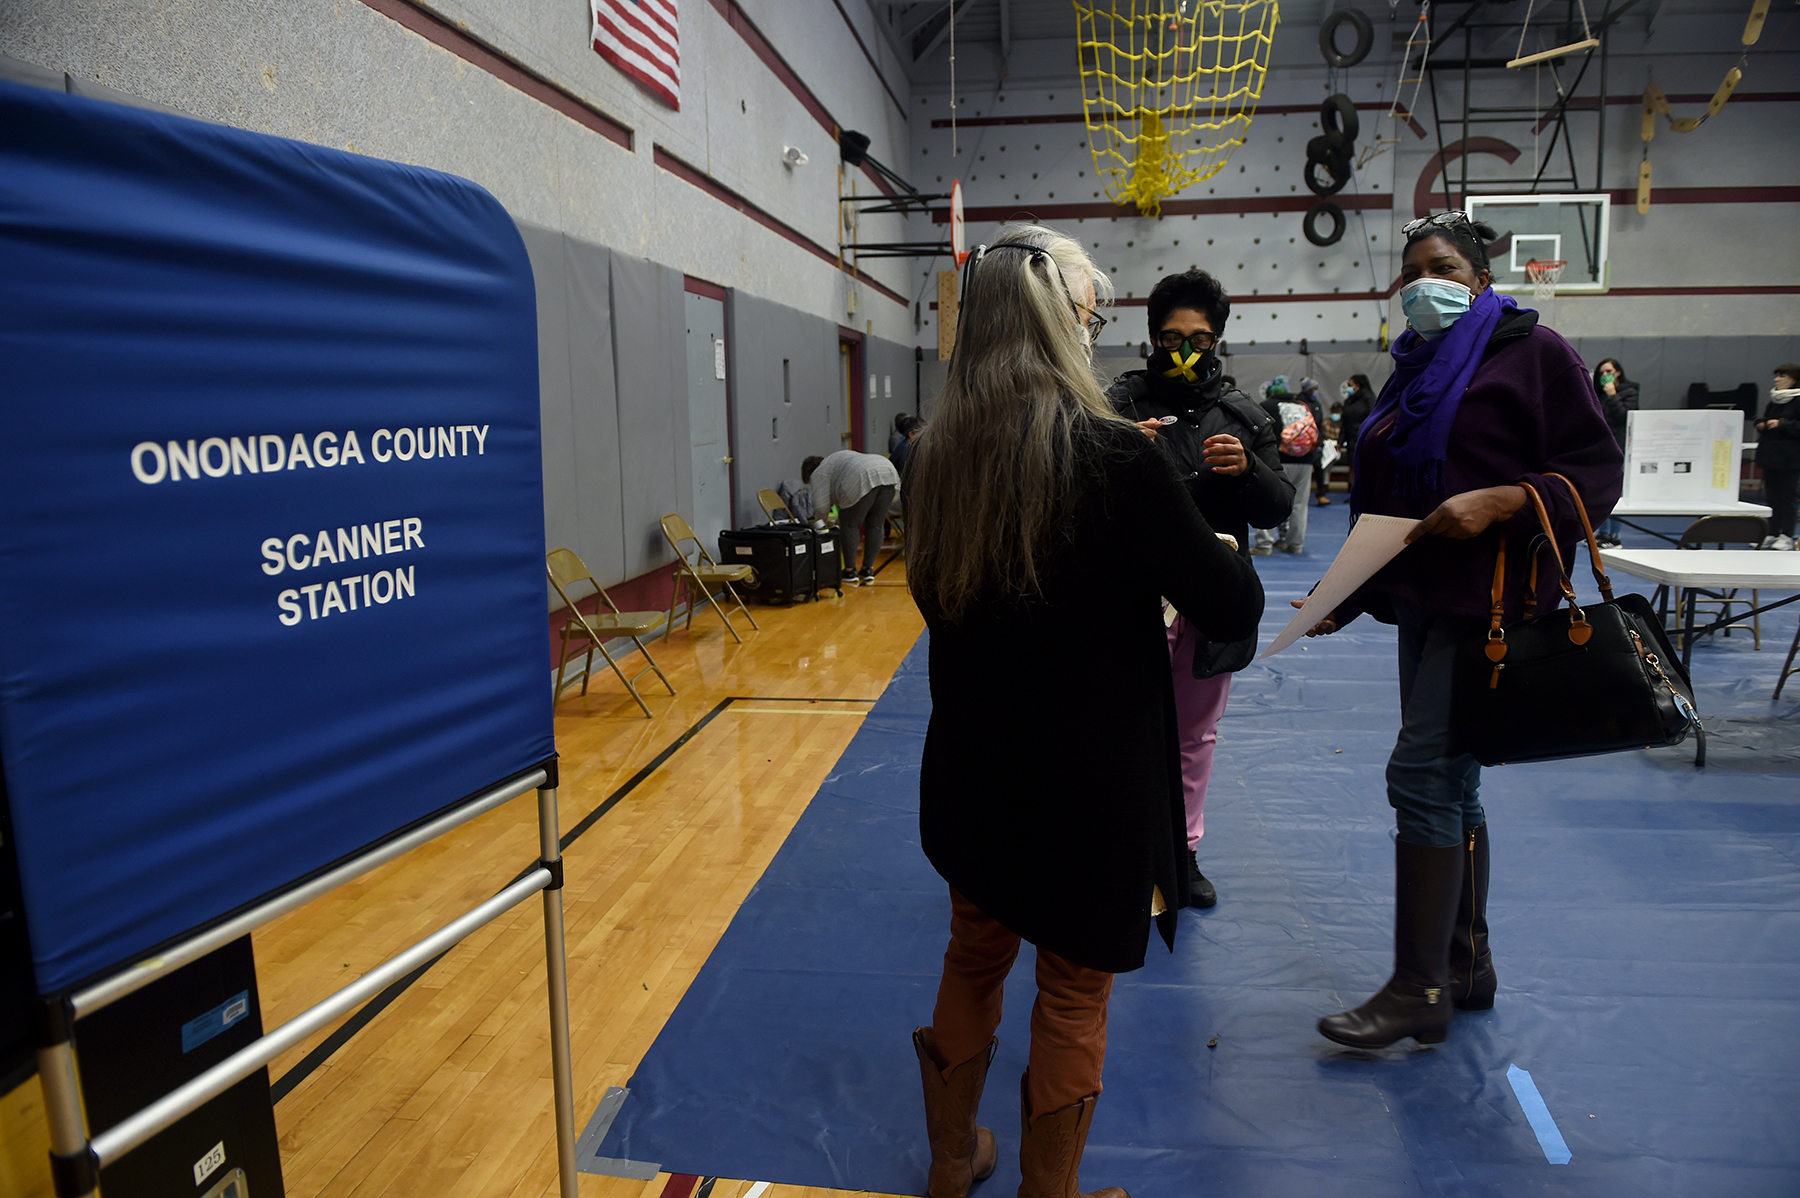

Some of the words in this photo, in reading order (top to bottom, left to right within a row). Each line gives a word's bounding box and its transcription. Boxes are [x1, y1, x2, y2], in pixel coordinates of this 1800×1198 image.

[131, 431, 365, 484] ONONDAGA
[371, 425, 489, 463] COUNTY
[261, 517, 425, 576] SCANNER
[277, 565, 416, 626] STATION
[198, 1149, 221, 1177] 125
